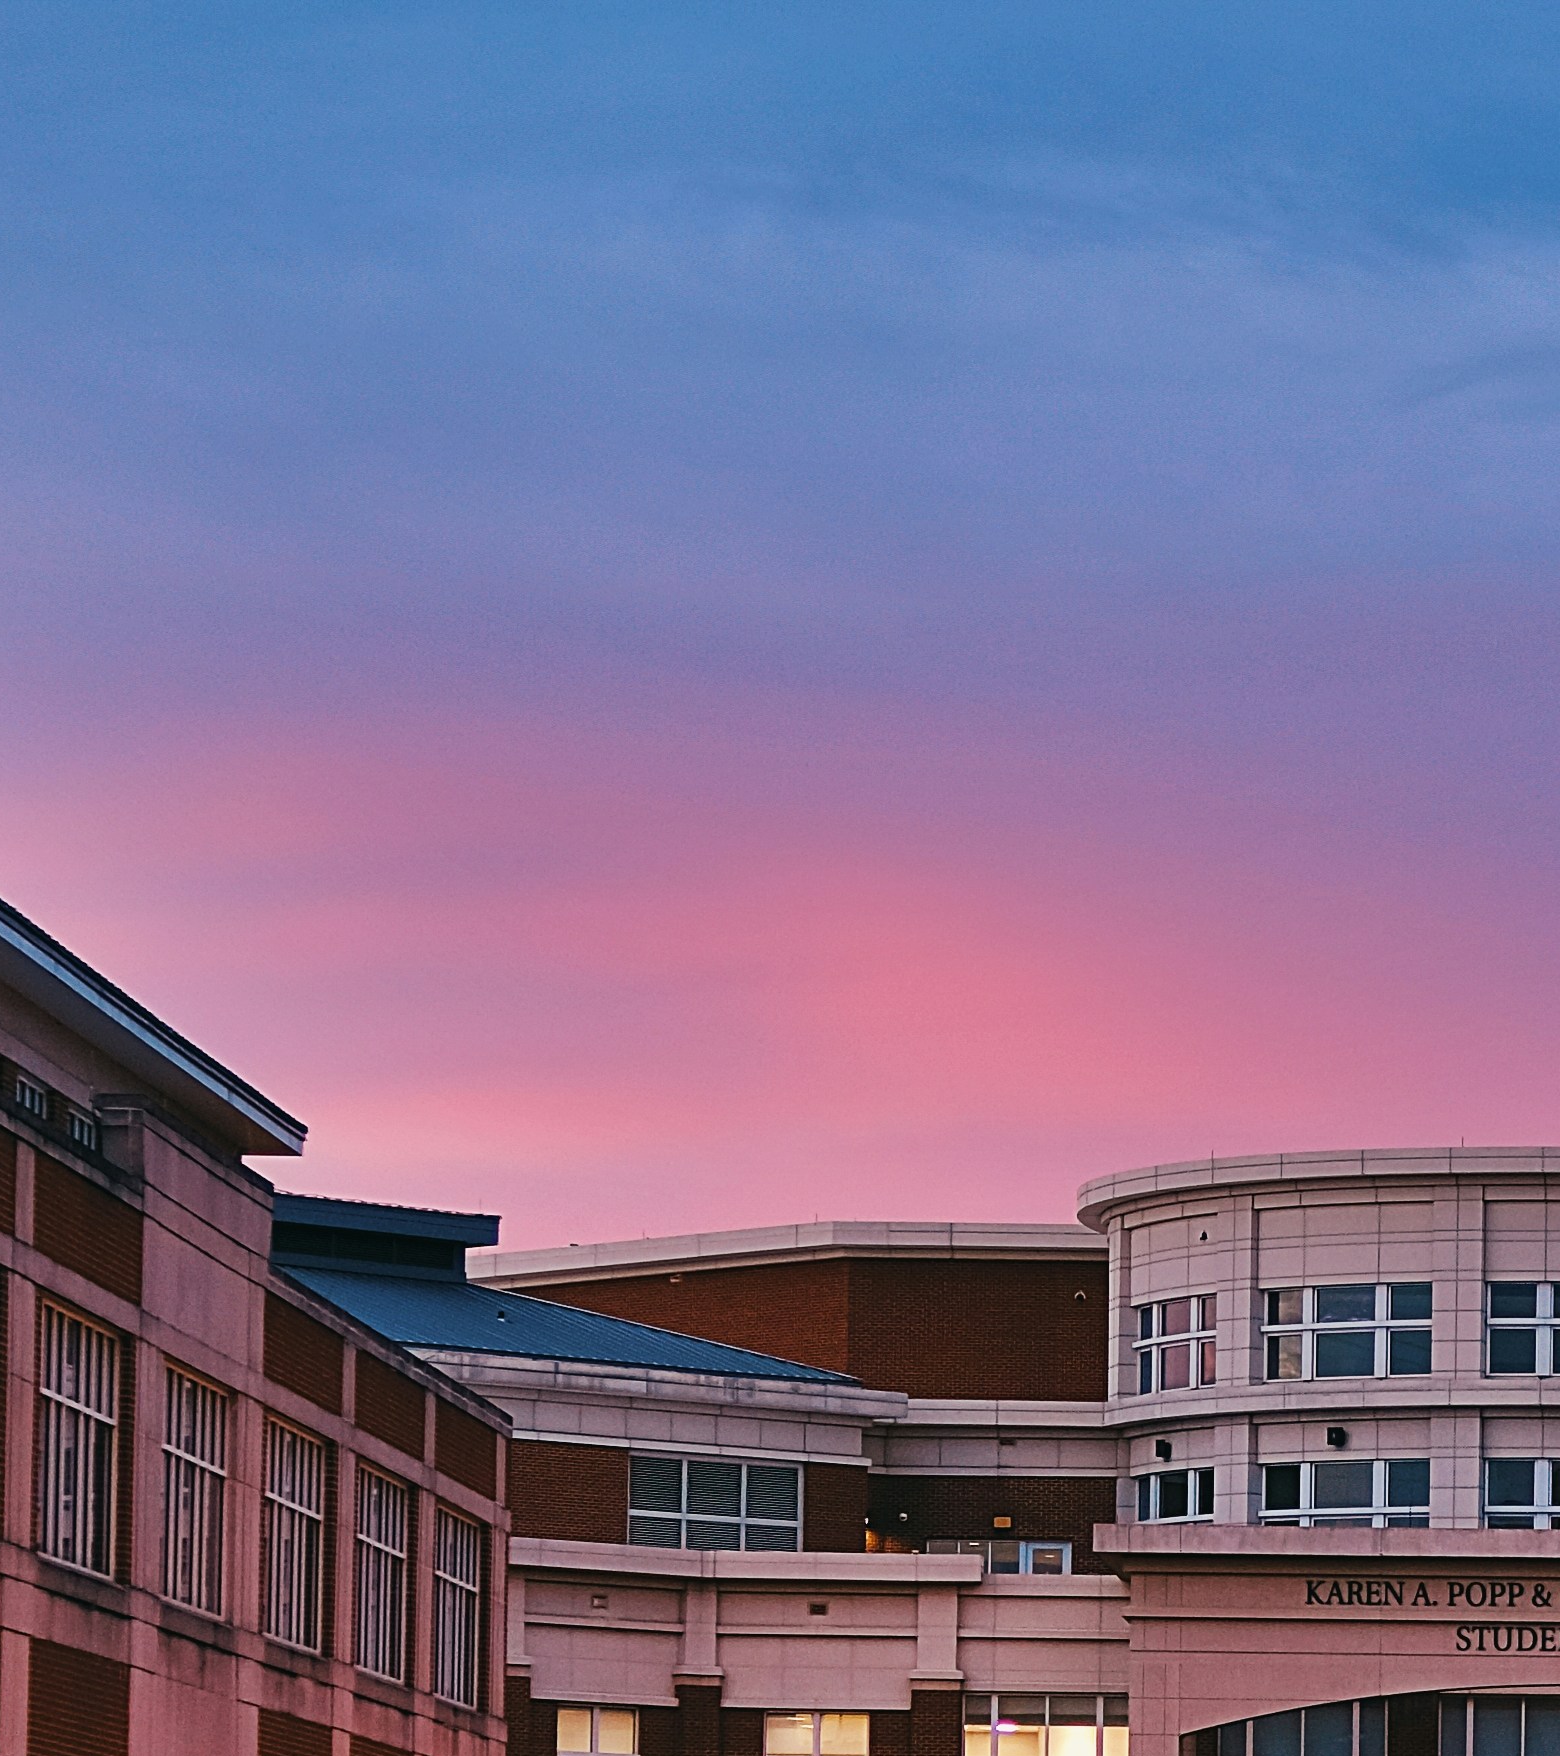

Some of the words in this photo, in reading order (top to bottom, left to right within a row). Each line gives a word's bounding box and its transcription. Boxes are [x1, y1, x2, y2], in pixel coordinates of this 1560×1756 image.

[1305, 1580, 1405, 1605] KAREN
[1411, 1581, 1438, 1606] A.
[1447, 1582, 1524, 1607] POPP
[1531, 1582, 1552, 1607] &
